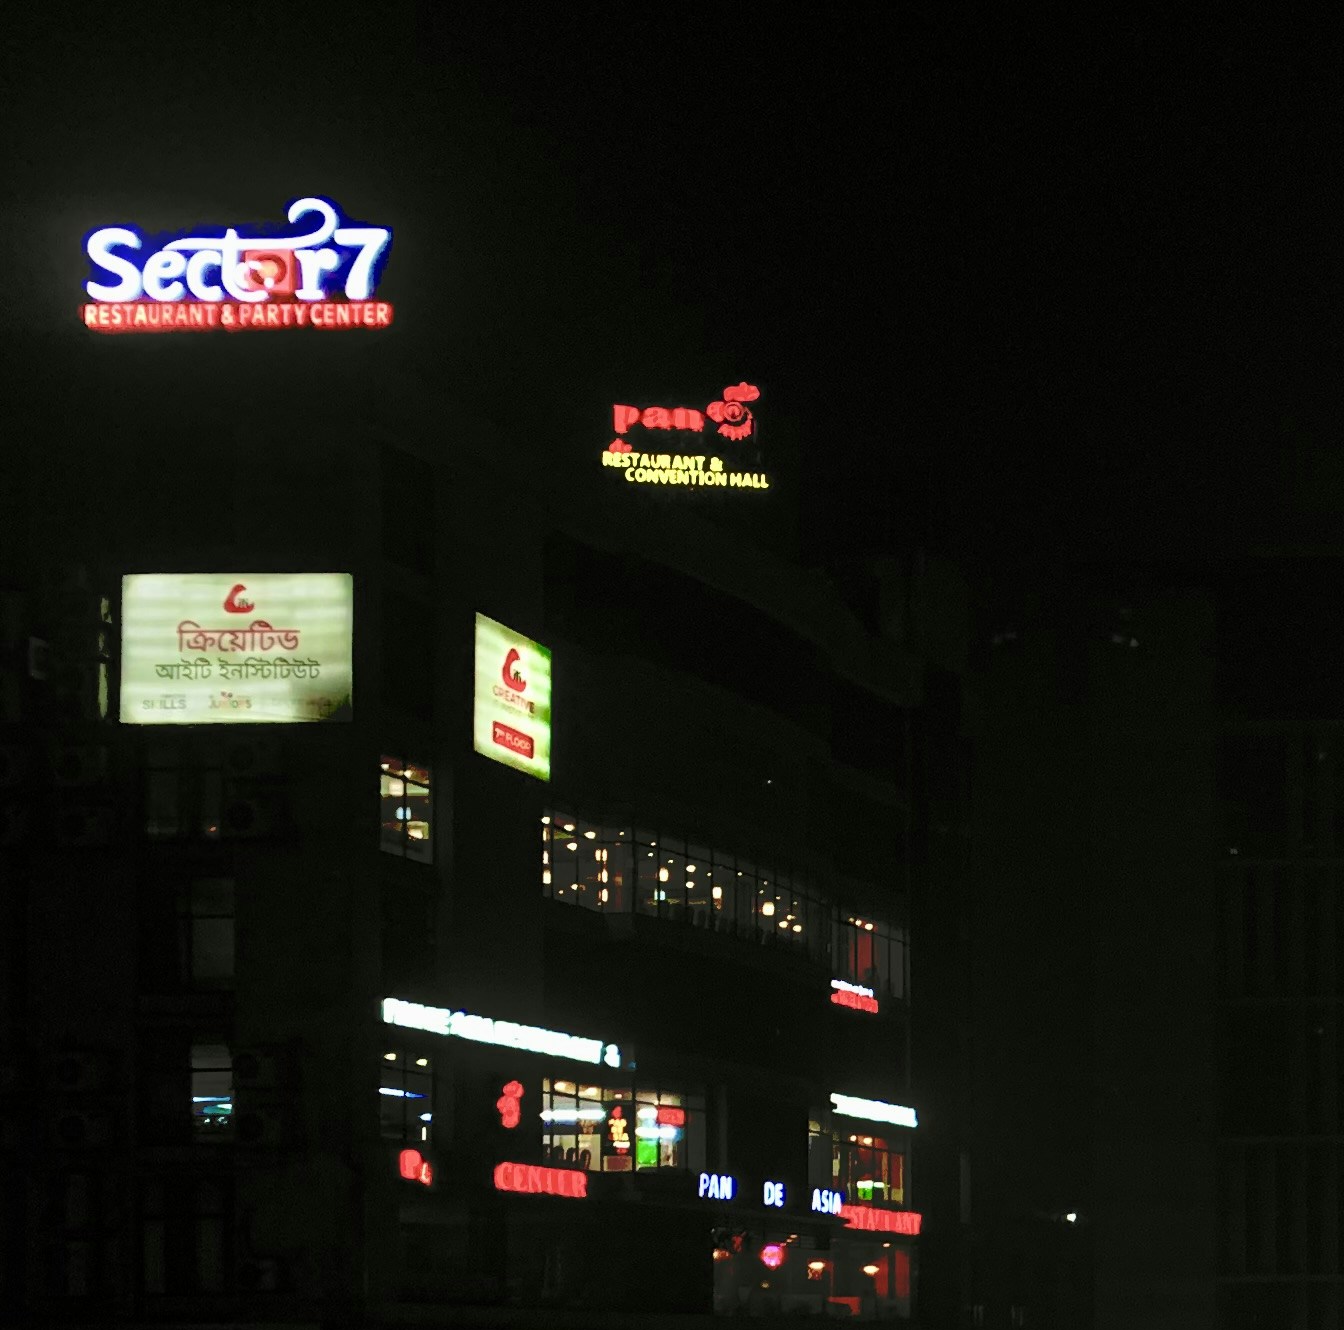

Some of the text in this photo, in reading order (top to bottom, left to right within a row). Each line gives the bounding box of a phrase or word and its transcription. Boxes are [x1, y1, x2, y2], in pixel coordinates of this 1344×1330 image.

[84, 303, 390, 327] RESTAURANT & PARTY CENTER
[613, 403, 705, 434] pan
[602, 451, 723, 471] RESTAURANT &
[624, 467, 769, 488] CONVENTION HALL
[177, 620, 300, 652] ক্রিয়েটিভ
[155, 657, 320, 680] আইটি ইনস্টিটিউট
[493, 685, 535, 714] CREATIVE
[698, 1173, 842, 1214] PAN DE ASIA
